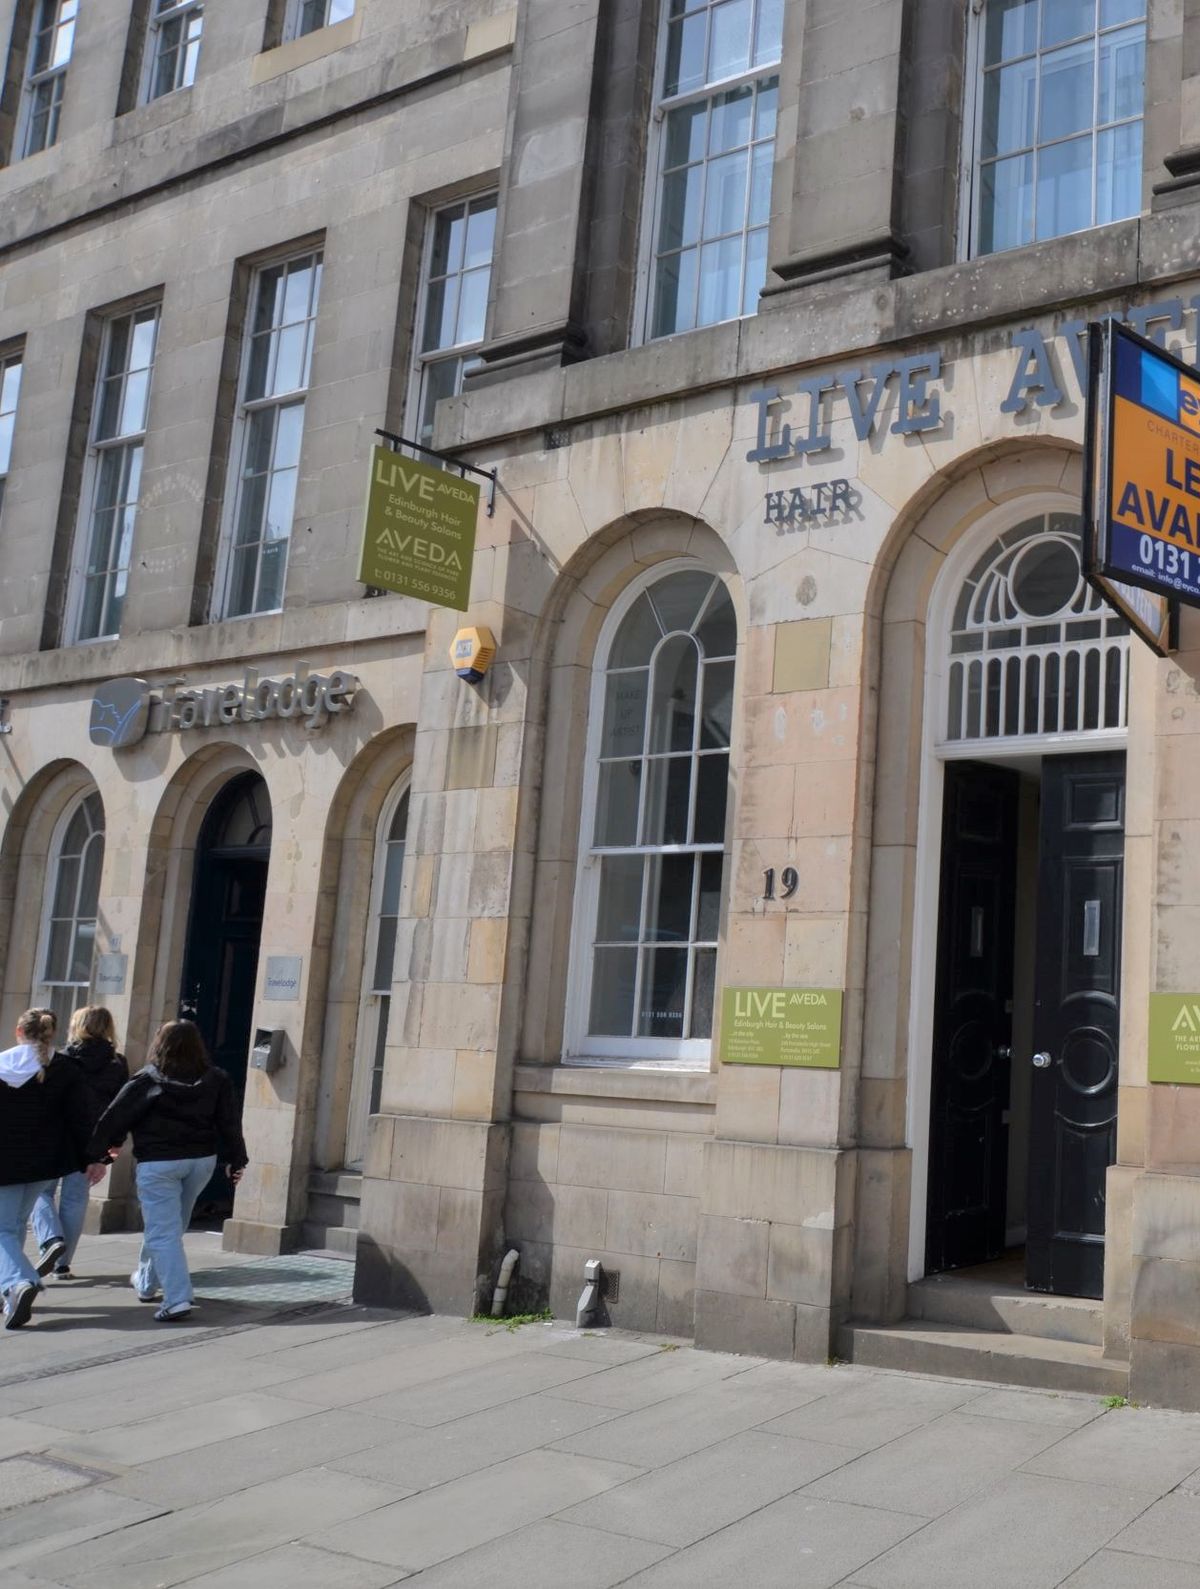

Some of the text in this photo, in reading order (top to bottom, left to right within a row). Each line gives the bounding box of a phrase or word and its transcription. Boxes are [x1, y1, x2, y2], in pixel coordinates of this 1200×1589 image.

[746, 351, 941, 463] LIVE
[376, 459, 476, 506] LIVE AVEDA
[388, 494, 462, 527] Edinburgh Hair
[764, 479, 851, 524] HAIR
[384, 506, 462, 540] & Beauty Salons
[376, 527, 463, 571] AVEDA
[1139, 535, 1190, 579] 0131
[383, 570, 408, 586] 0131
[411, 578, 430, 592] 556
[432, 584, 457, 600] 9356
[762, 867, 799, 900] 19
[734, 991, 828, 1018] LIVE AVEDA
[734, 1019, 764, 1030] Edinburgh
[779, 1021, 785, 1029] &
[806, 1022, 828, 1031] Salons
